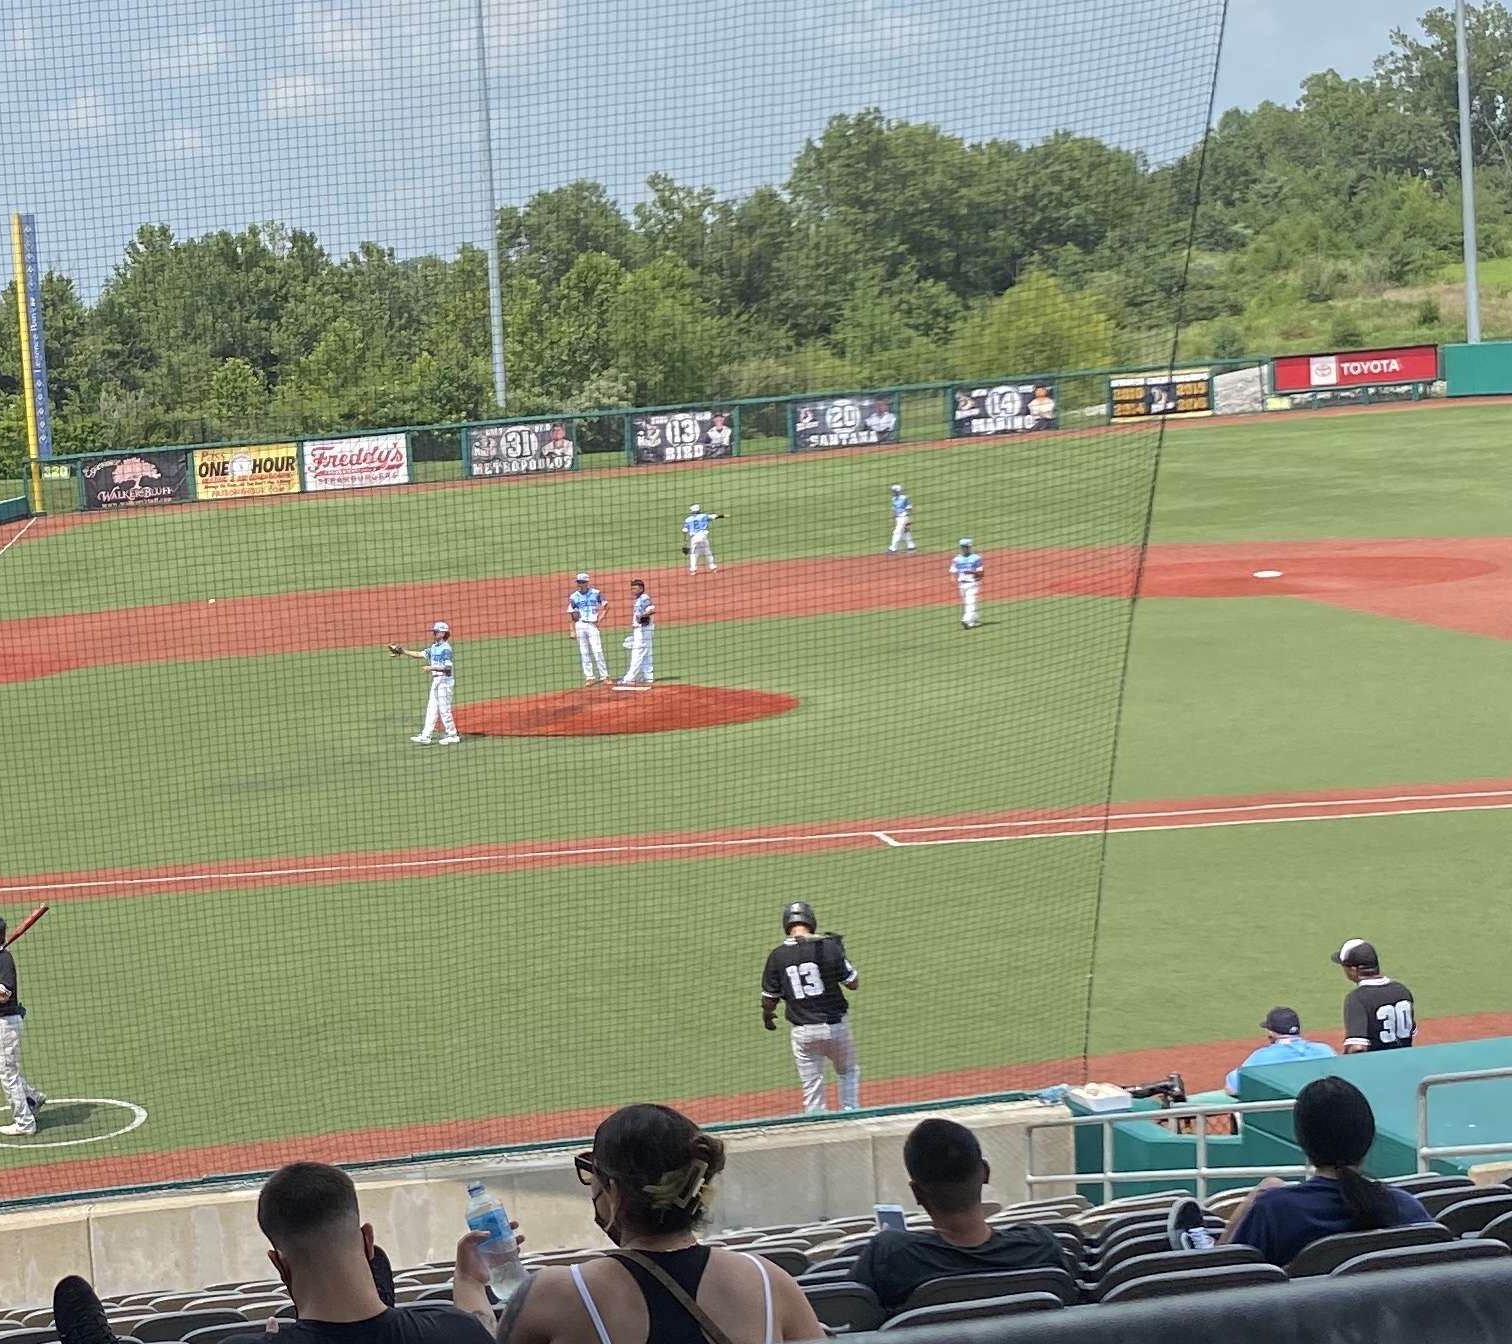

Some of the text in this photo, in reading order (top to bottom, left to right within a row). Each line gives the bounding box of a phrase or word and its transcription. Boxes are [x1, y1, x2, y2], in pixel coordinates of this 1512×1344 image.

[1340, 359, 1400, 376] TOYOTA
[991, 391, 1017, 415] 14
[830, 406, 858, 428] 20
[671, 418, 696, 444] 13
[809, 430, 879, 447] SANTANA
[505, 430, 533, 459] 31
[665, 444, 704, 461] BIRD
[198, 461, 230, 478] ONE
[251, 456, 296, 474] HOUR
[308, 442, 404, 472] Freddy's
[42, 464, 70, 479] 320
[785, 961, 825, 1000] 13
[1376, 999, 1413, 1044] 30
